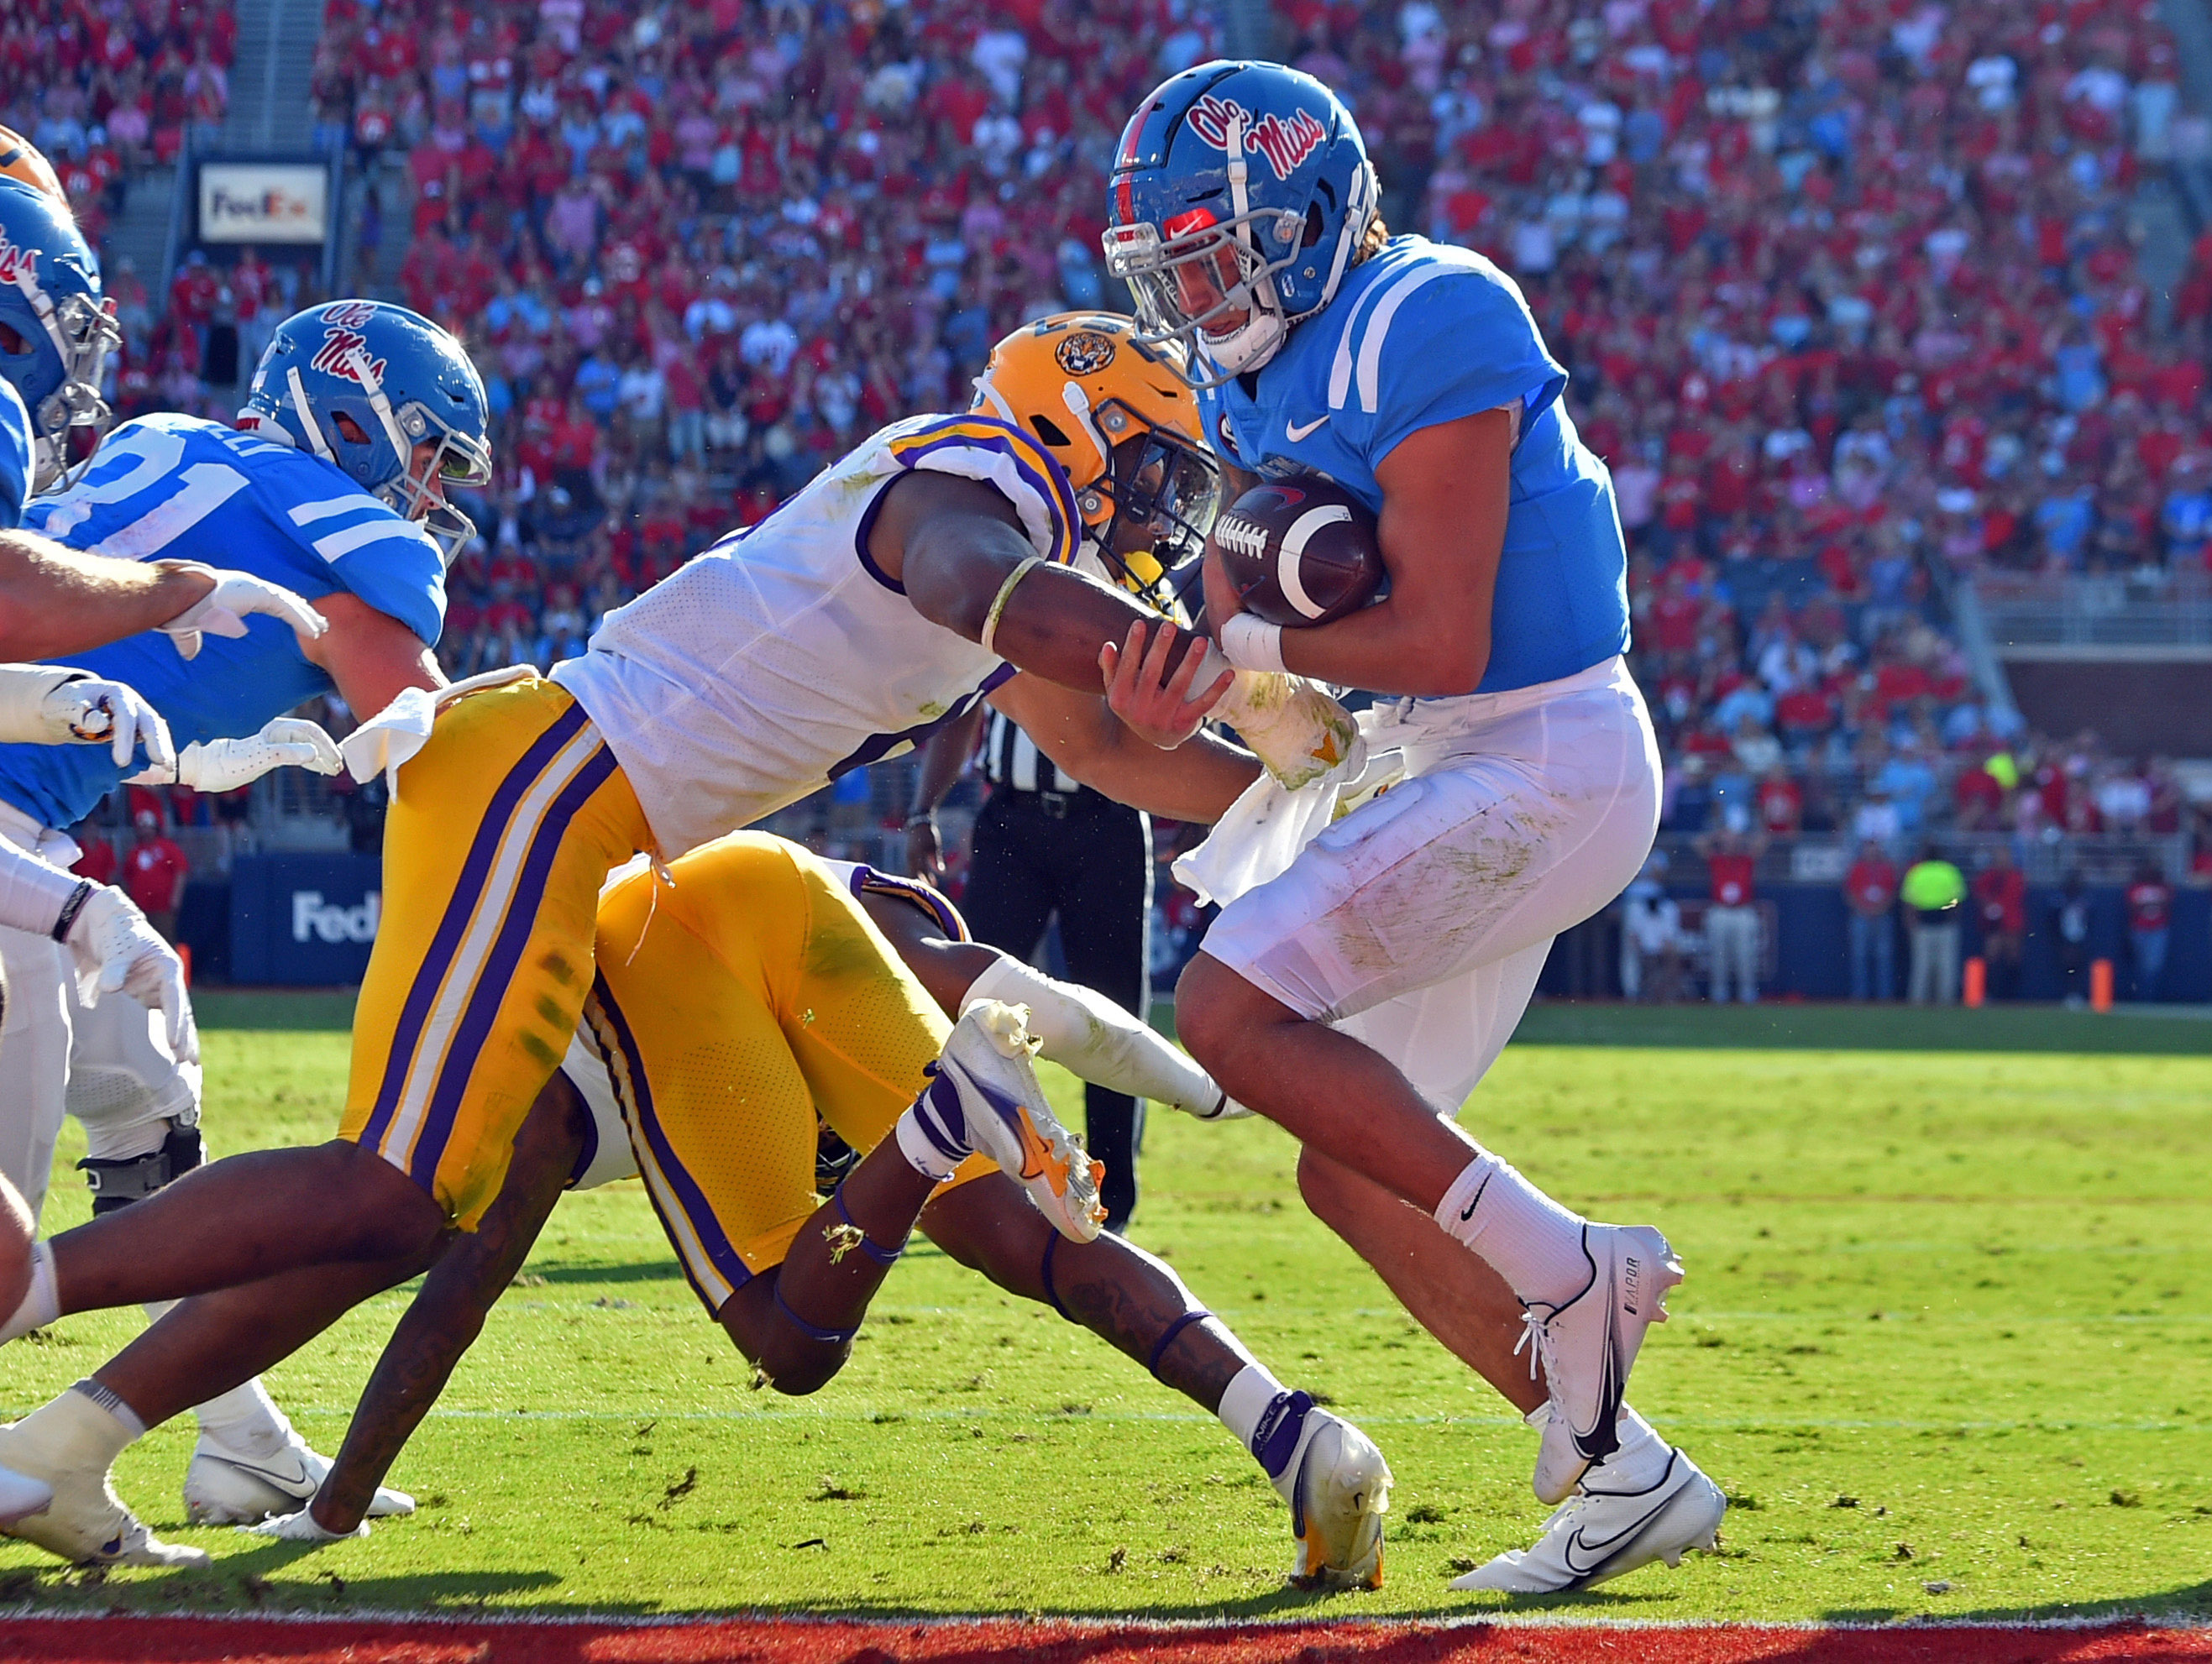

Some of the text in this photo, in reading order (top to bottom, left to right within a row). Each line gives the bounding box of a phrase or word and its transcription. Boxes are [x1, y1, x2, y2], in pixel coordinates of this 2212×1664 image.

[1244, 107, 1327, 181] Miss
[320, 302, 377, 329] Ole
[292, 890, 382, 942] Fed
